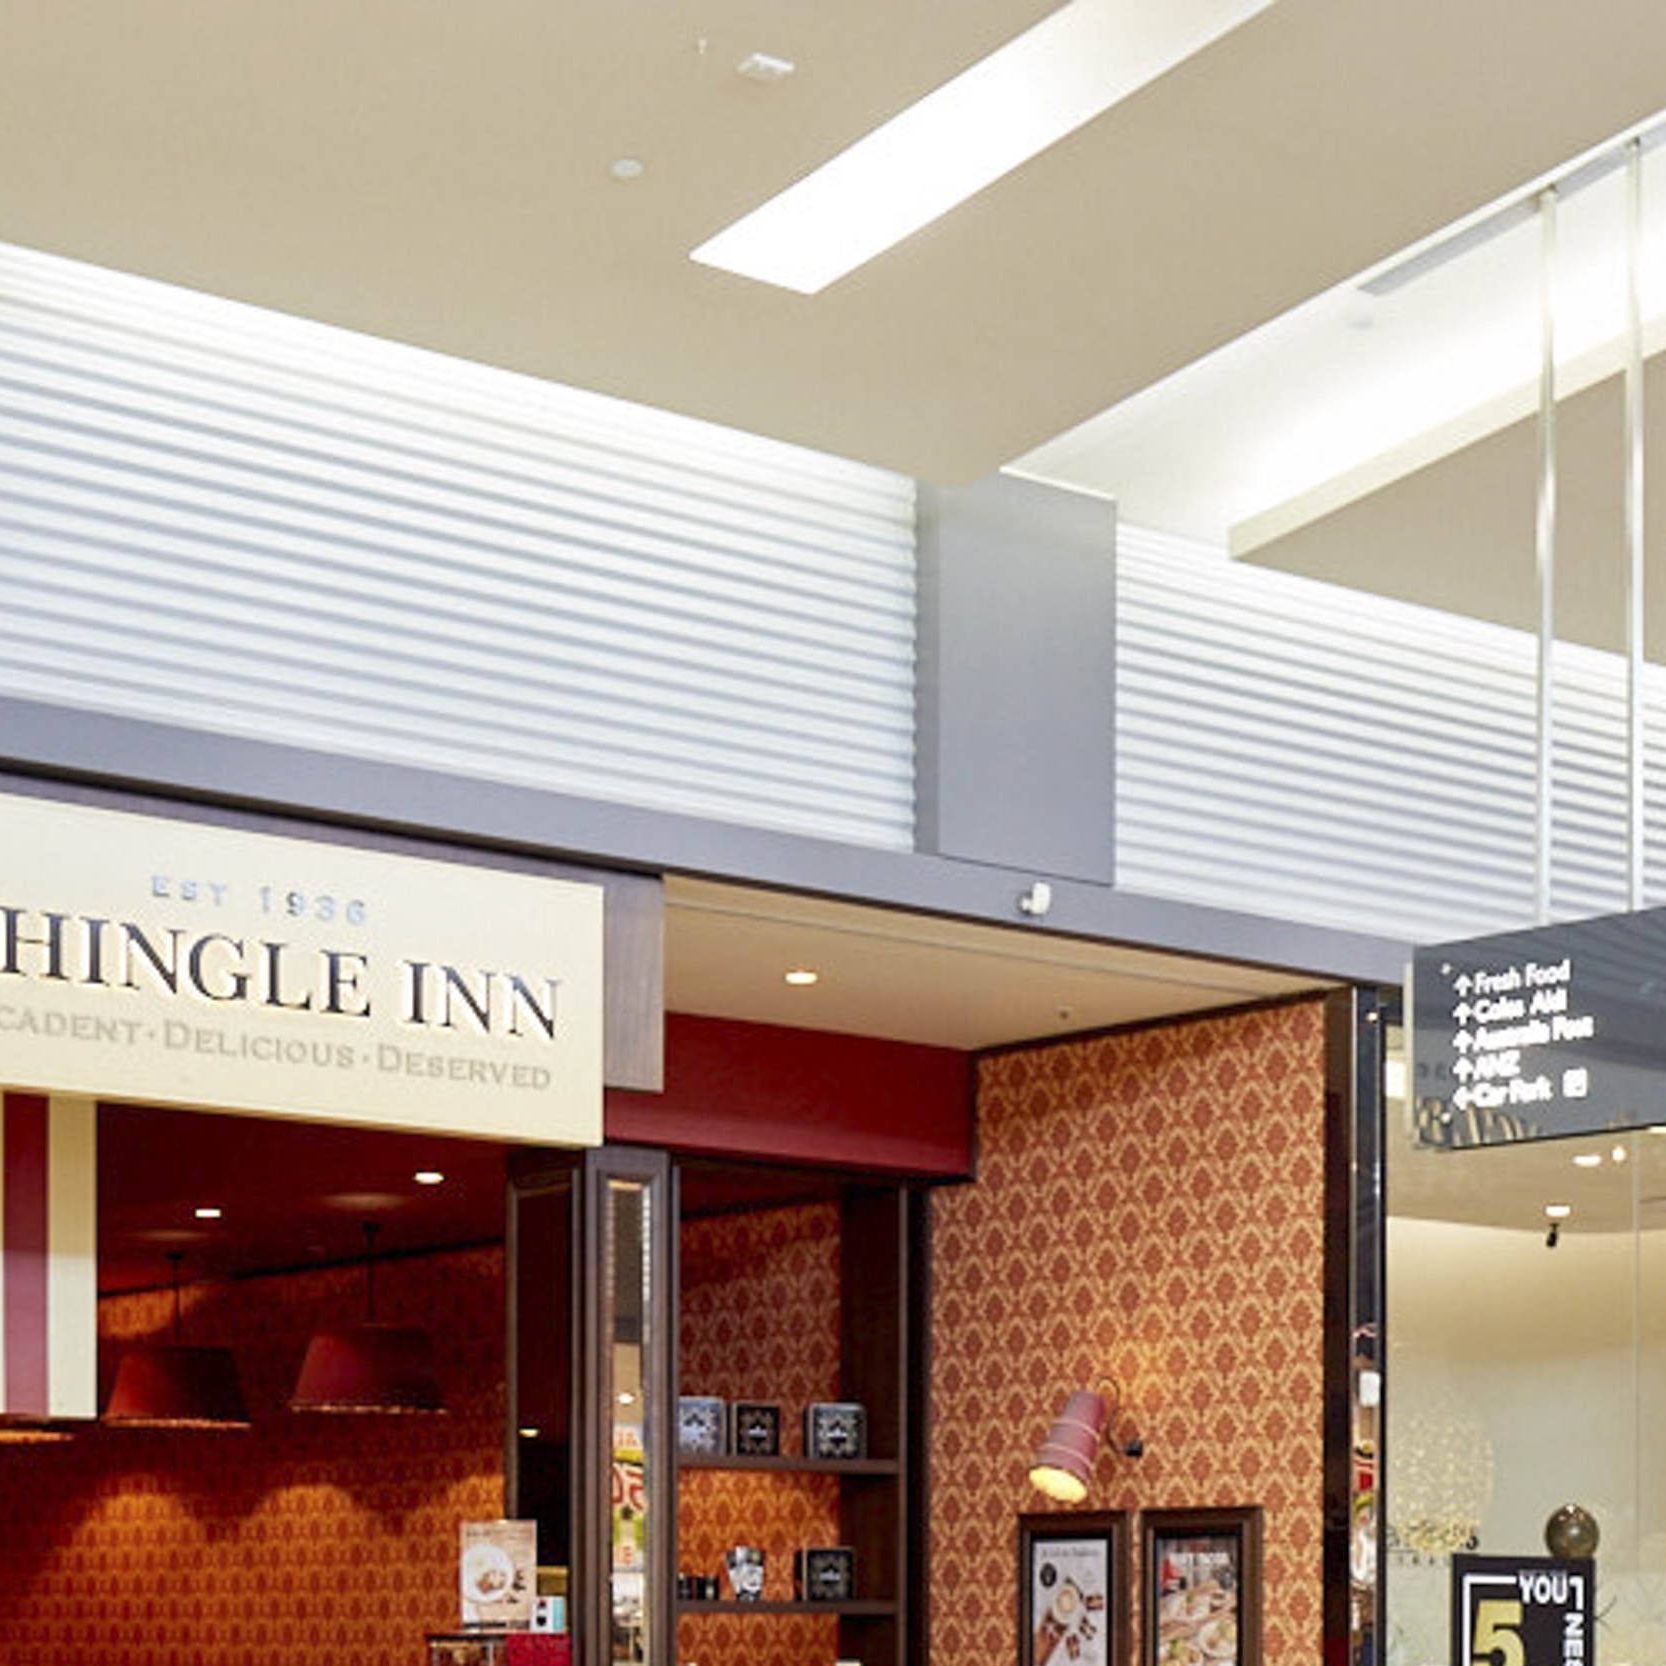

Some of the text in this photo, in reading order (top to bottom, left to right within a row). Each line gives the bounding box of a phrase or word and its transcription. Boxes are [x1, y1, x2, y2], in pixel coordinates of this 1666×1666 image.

[151, 873, 367, 926] EST 1936
[1474, 957, 1571, 995] Fresh Food
[403, 959, 562, 1041] INN
[1518, 1569, 1569, 1606] YOU
